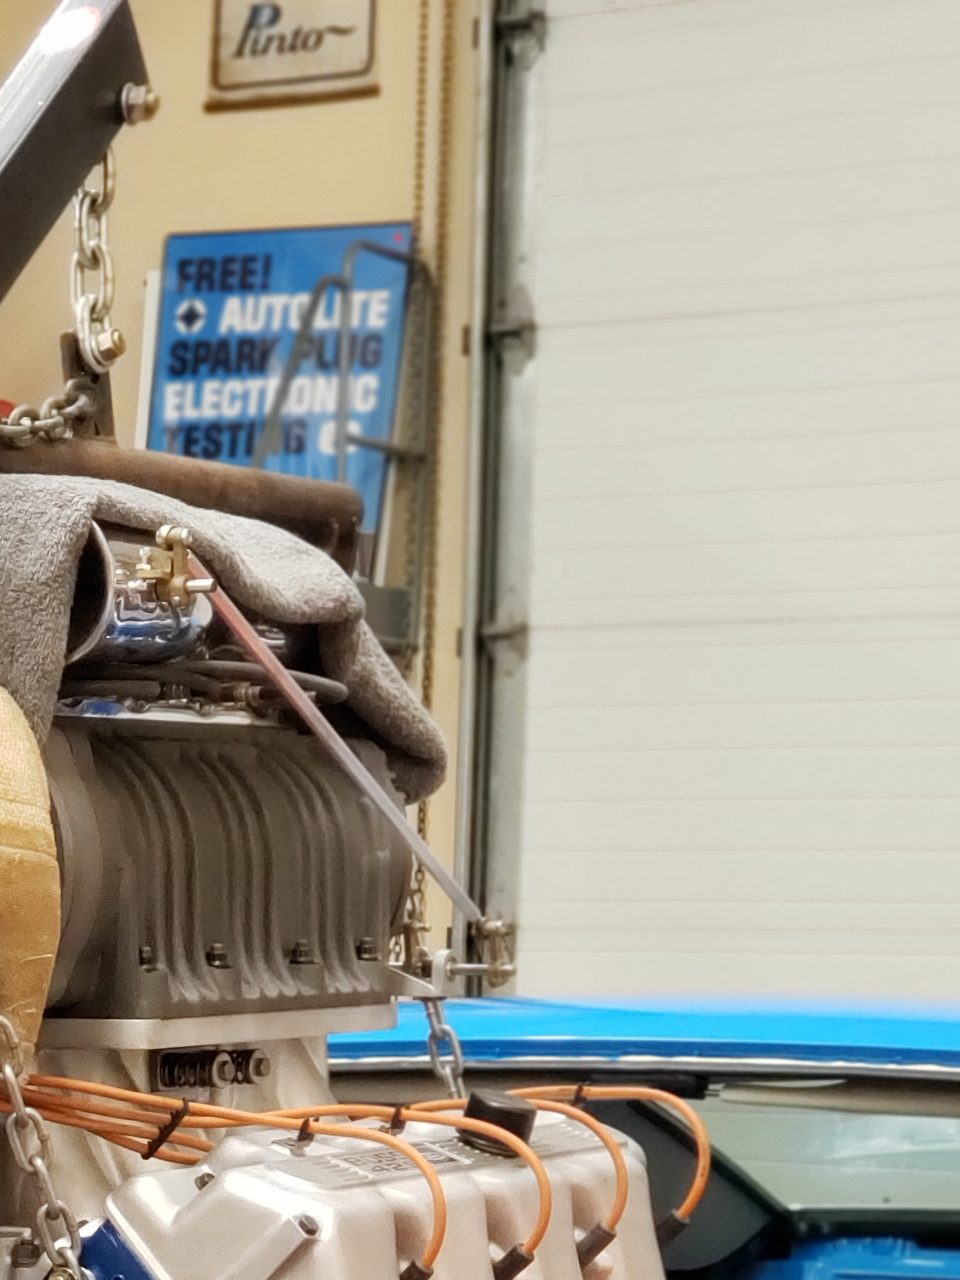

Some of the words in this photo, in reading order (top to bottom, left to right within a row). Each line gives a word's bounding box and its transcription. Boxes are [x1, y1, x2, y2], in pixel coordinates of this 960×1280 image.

[230, 2, 356, 59] Pinto
[176, 253, 272, 293] FREE!
[219, 290, 390, 334] AUTOLITE
[168, 337, 279, 377] SPARK
[164, 417, 309, 460] TESTIG
